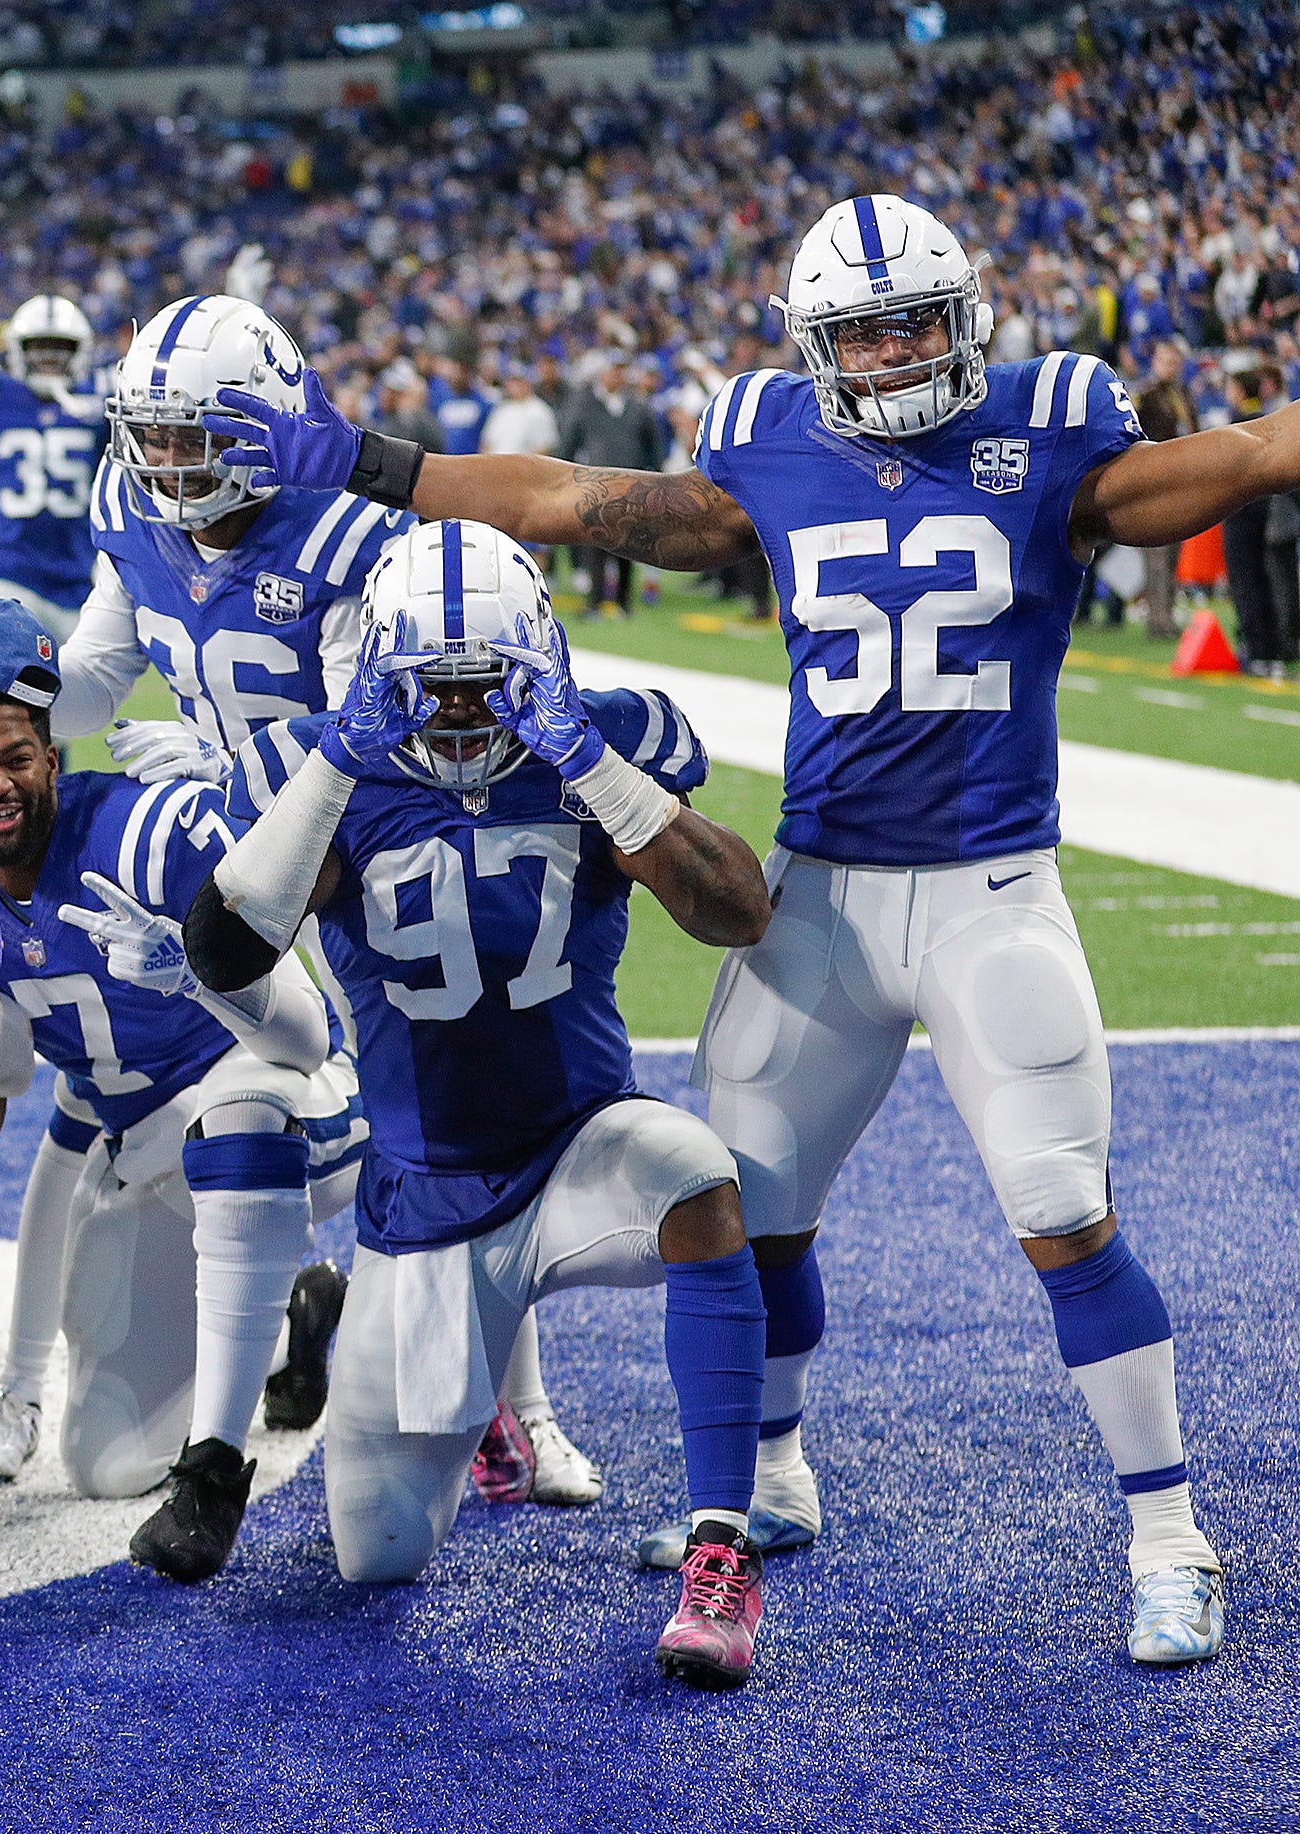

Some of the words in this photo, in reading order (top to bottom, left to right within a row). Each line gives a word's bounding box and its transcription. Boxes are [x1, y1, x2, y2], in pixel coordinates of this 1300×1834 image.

[871, 279, 895, 296] COLTS
[1107, 382, 1148, 439] 5
[975, 440, 1026, 474] 35
[980, 470, 1016, 480] SEASONS
[256, 575, 303, 612] 35
[786, 515, 1012, 718] 52
[444, 641, 466, 655] COLTS
[135, 606, 313, 748] 36
[186, 808, 237, 852] 7
[361, 823, 583, 1022] 97
[143, 953, 185, 971] adida
[8, 972, 156, 1097] 7
